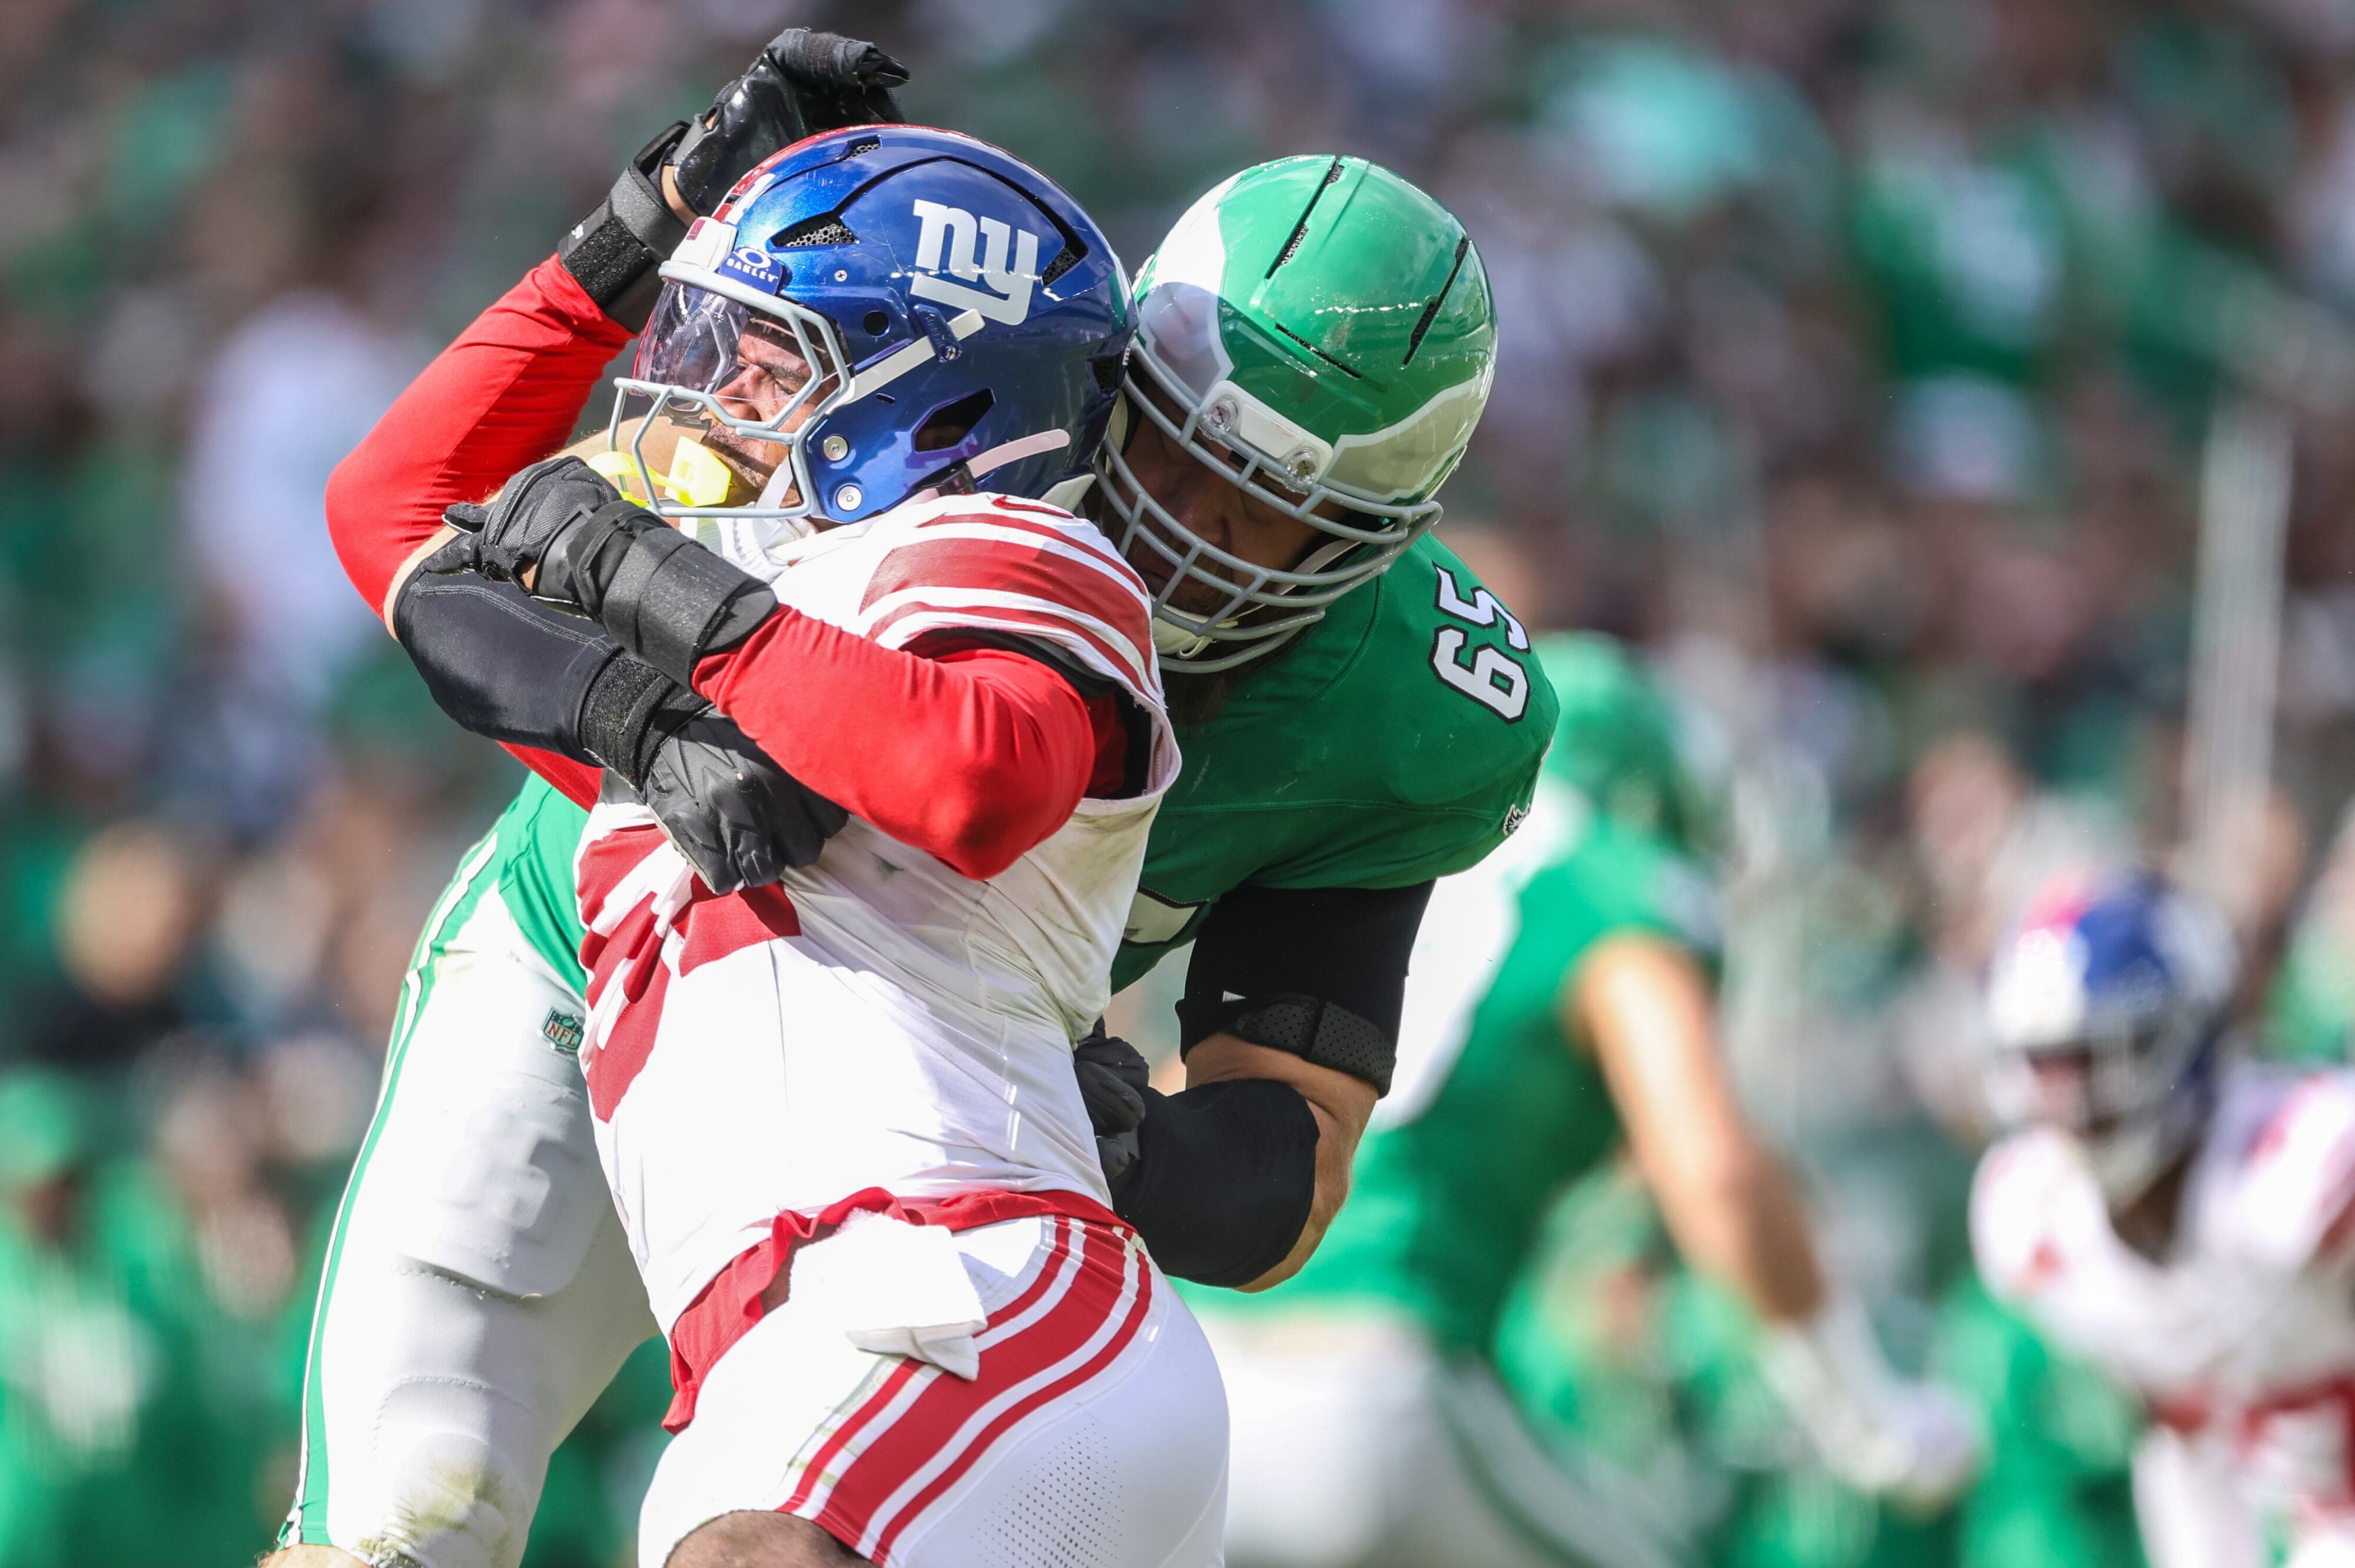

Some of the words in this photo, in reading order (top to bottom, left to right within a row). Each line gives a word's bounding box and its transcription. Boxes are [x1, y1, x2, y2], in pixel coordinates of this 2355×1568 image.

[726, 258, 777, 283] OAKLEY
[1428, 560, 1531, 724] 65
[548, 1022, 576, 1046] NFL
